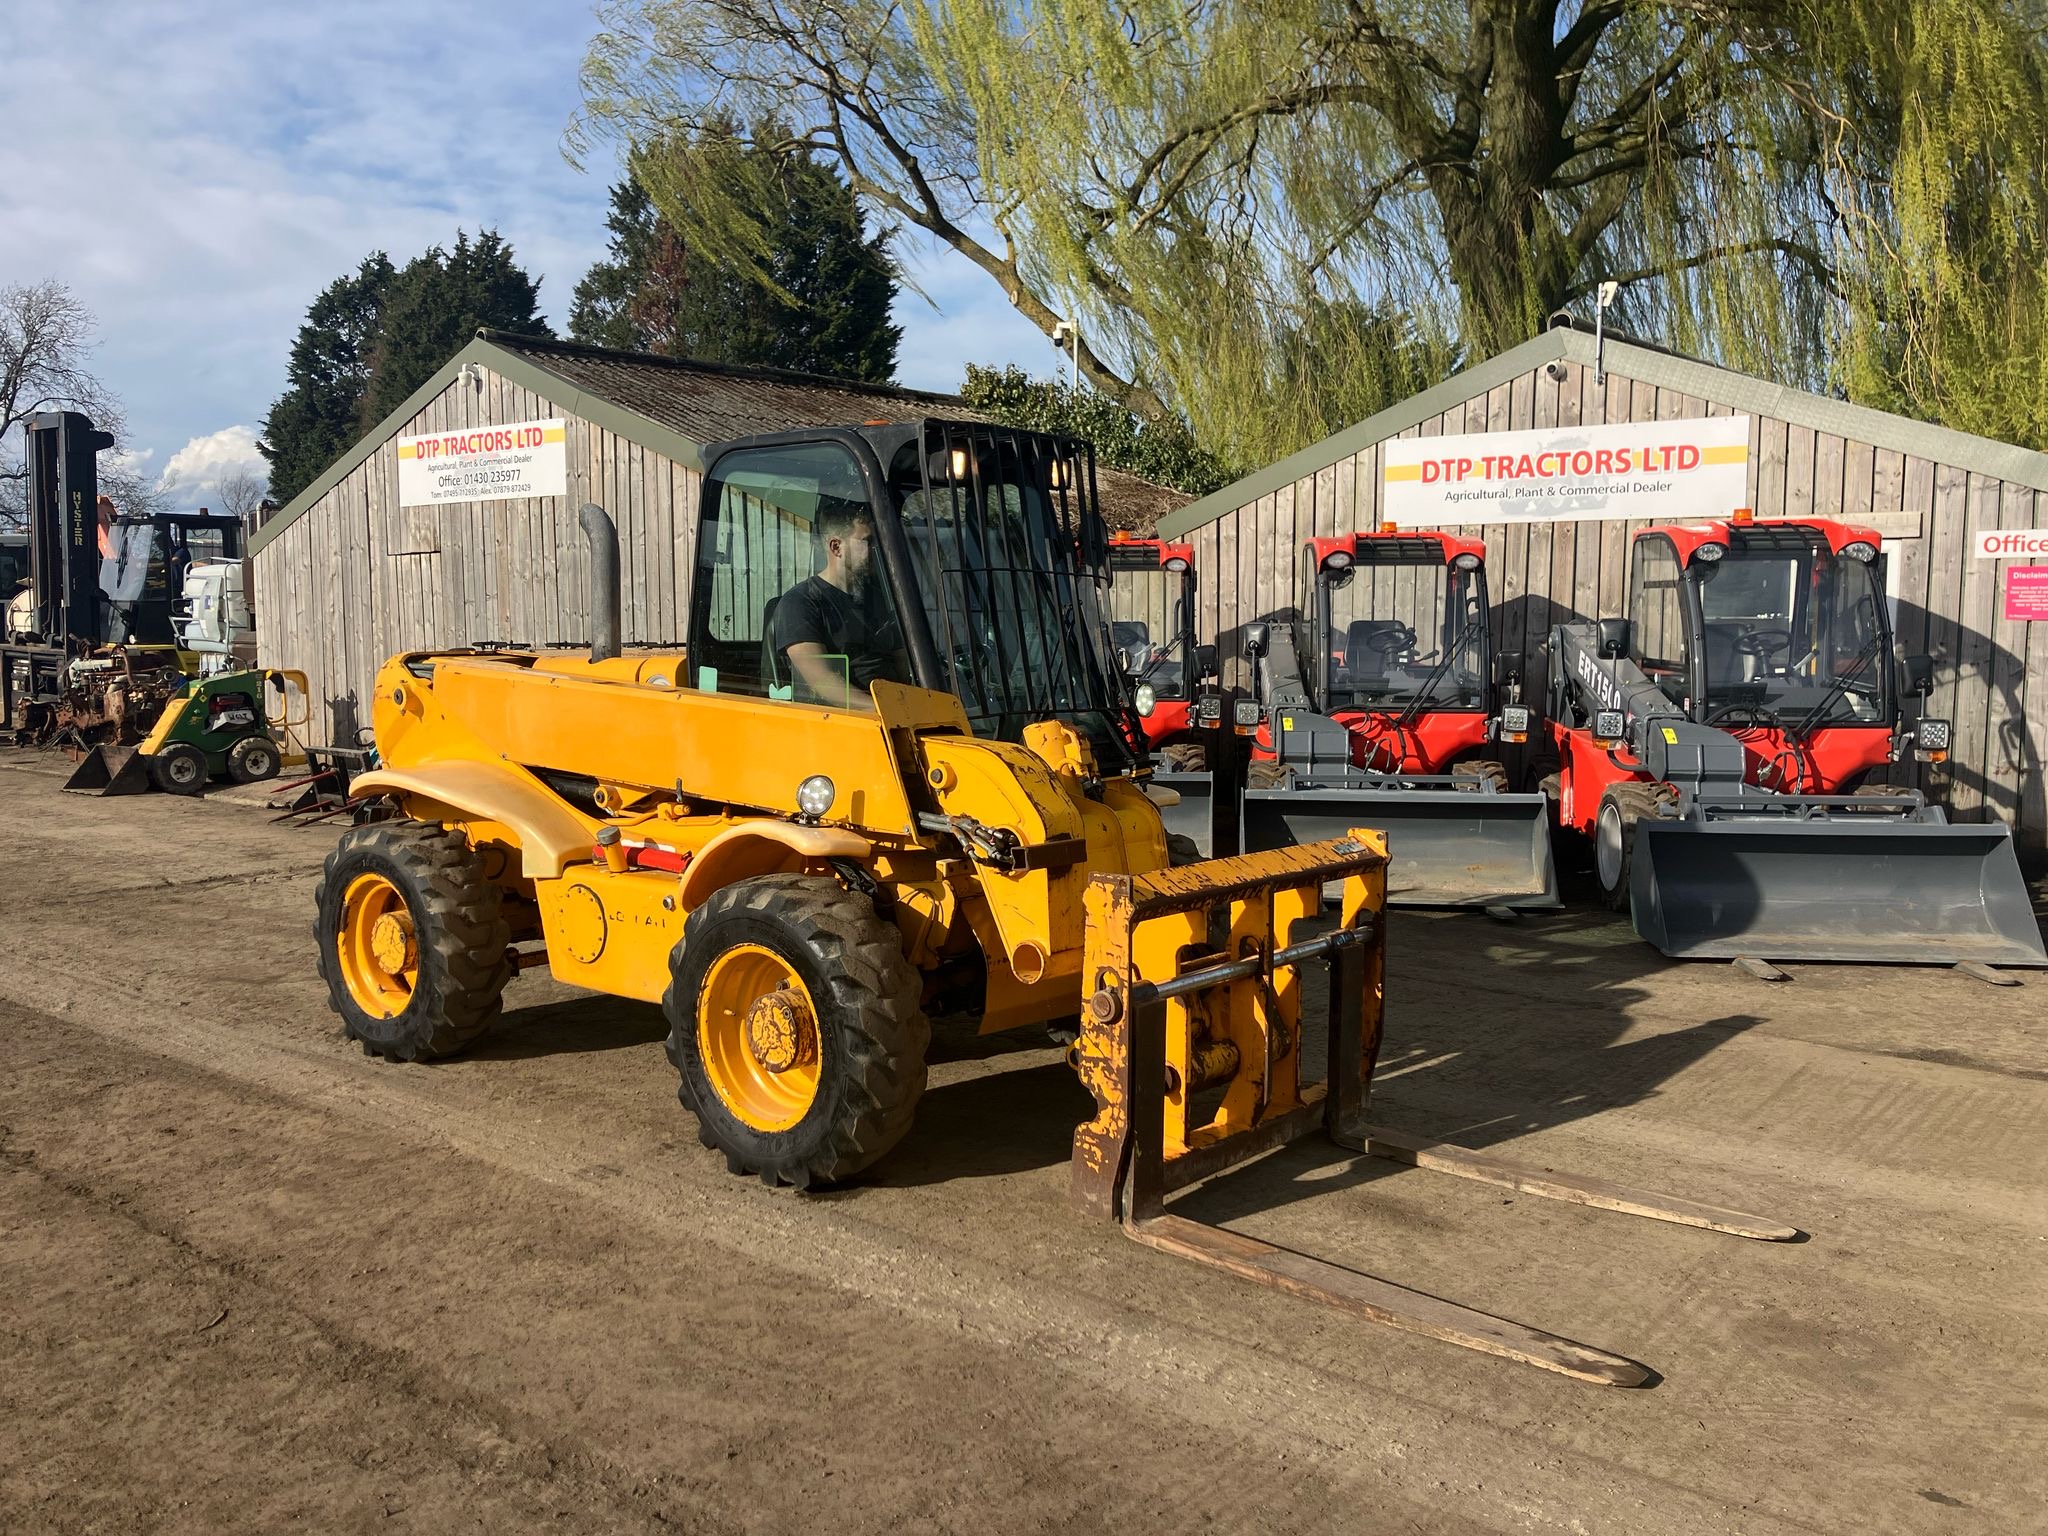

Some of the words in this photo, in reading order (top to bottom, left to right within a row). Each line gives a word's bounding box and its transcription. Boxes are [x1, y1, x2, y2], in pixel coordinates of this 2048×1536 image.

[416, 439, 440, 459] DTP
[443, 430, 513, 457] TRACTORS
[517, 427, 543, 449] LTD
[428, 461, 458, 473] Agricultural,
[459, 460, 473, 469] Plant
[474, 459, 479, 467] &
[479, 455, 513, 467] Commercial
[513, 453, 533, 464] Dealer
[1421, 458, 1473, 484] DTP
[1481, 448, 1632, 480] TRACTORS
[1643, 444, 1700, 473] LTD
[438, 475, 463, 488] Office:
[464, 472, 488, 485] 01430
[491, 469, 521, 483] 235977
[1445, 488, 1512, 504] Agricultural,
[1515, 487, 1544, 498] Plant
[1547, 486, 1556, 497] &
[1559, 482, 1629, 497] Commercial
[1633, 481, 1673, 493] Dealer
[72, 491, 84, 546] HYSTER
[1983, 534, 2048, 553] Office
